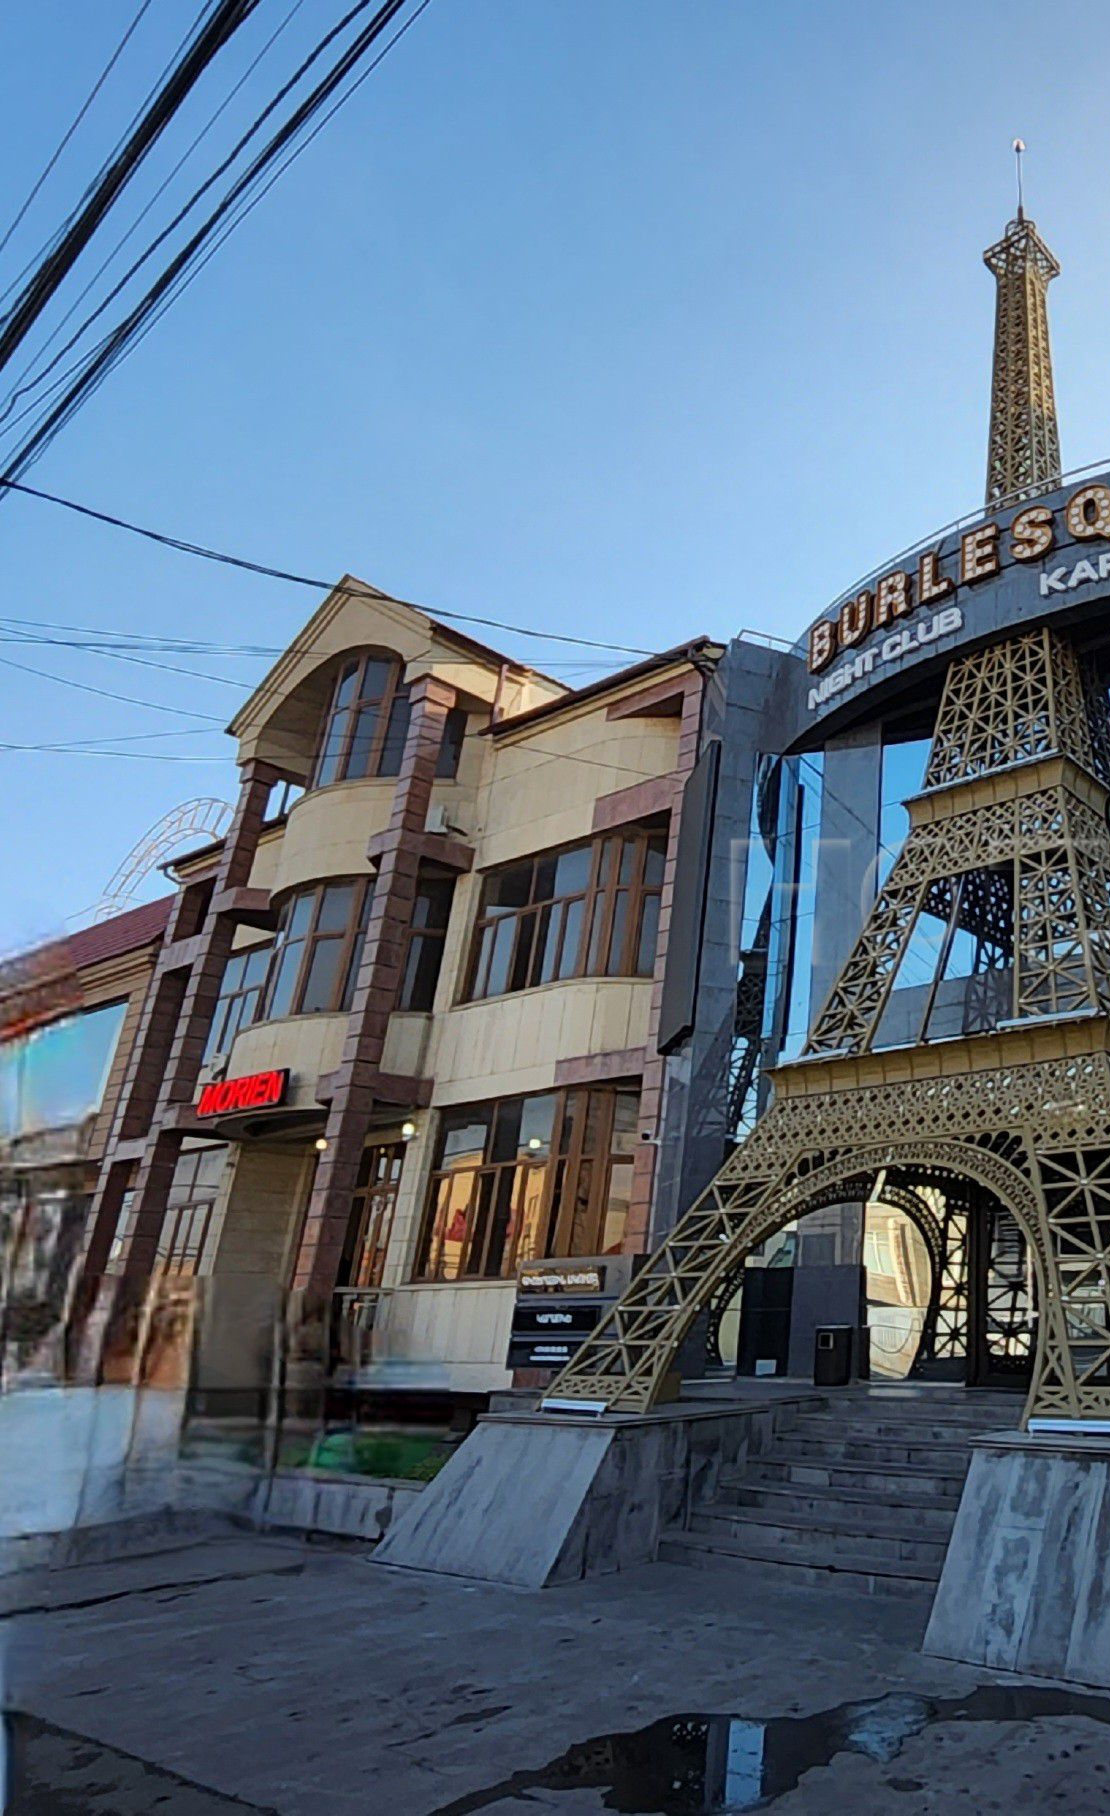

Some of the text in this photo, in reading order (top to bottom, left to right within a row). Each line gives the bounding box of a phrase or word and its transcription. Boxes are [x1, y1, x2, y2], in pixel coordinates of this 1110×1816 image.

[807, 607, 963, 710] NIGHT CLUB
[197, 1070, 285, 1118] MORIEN
